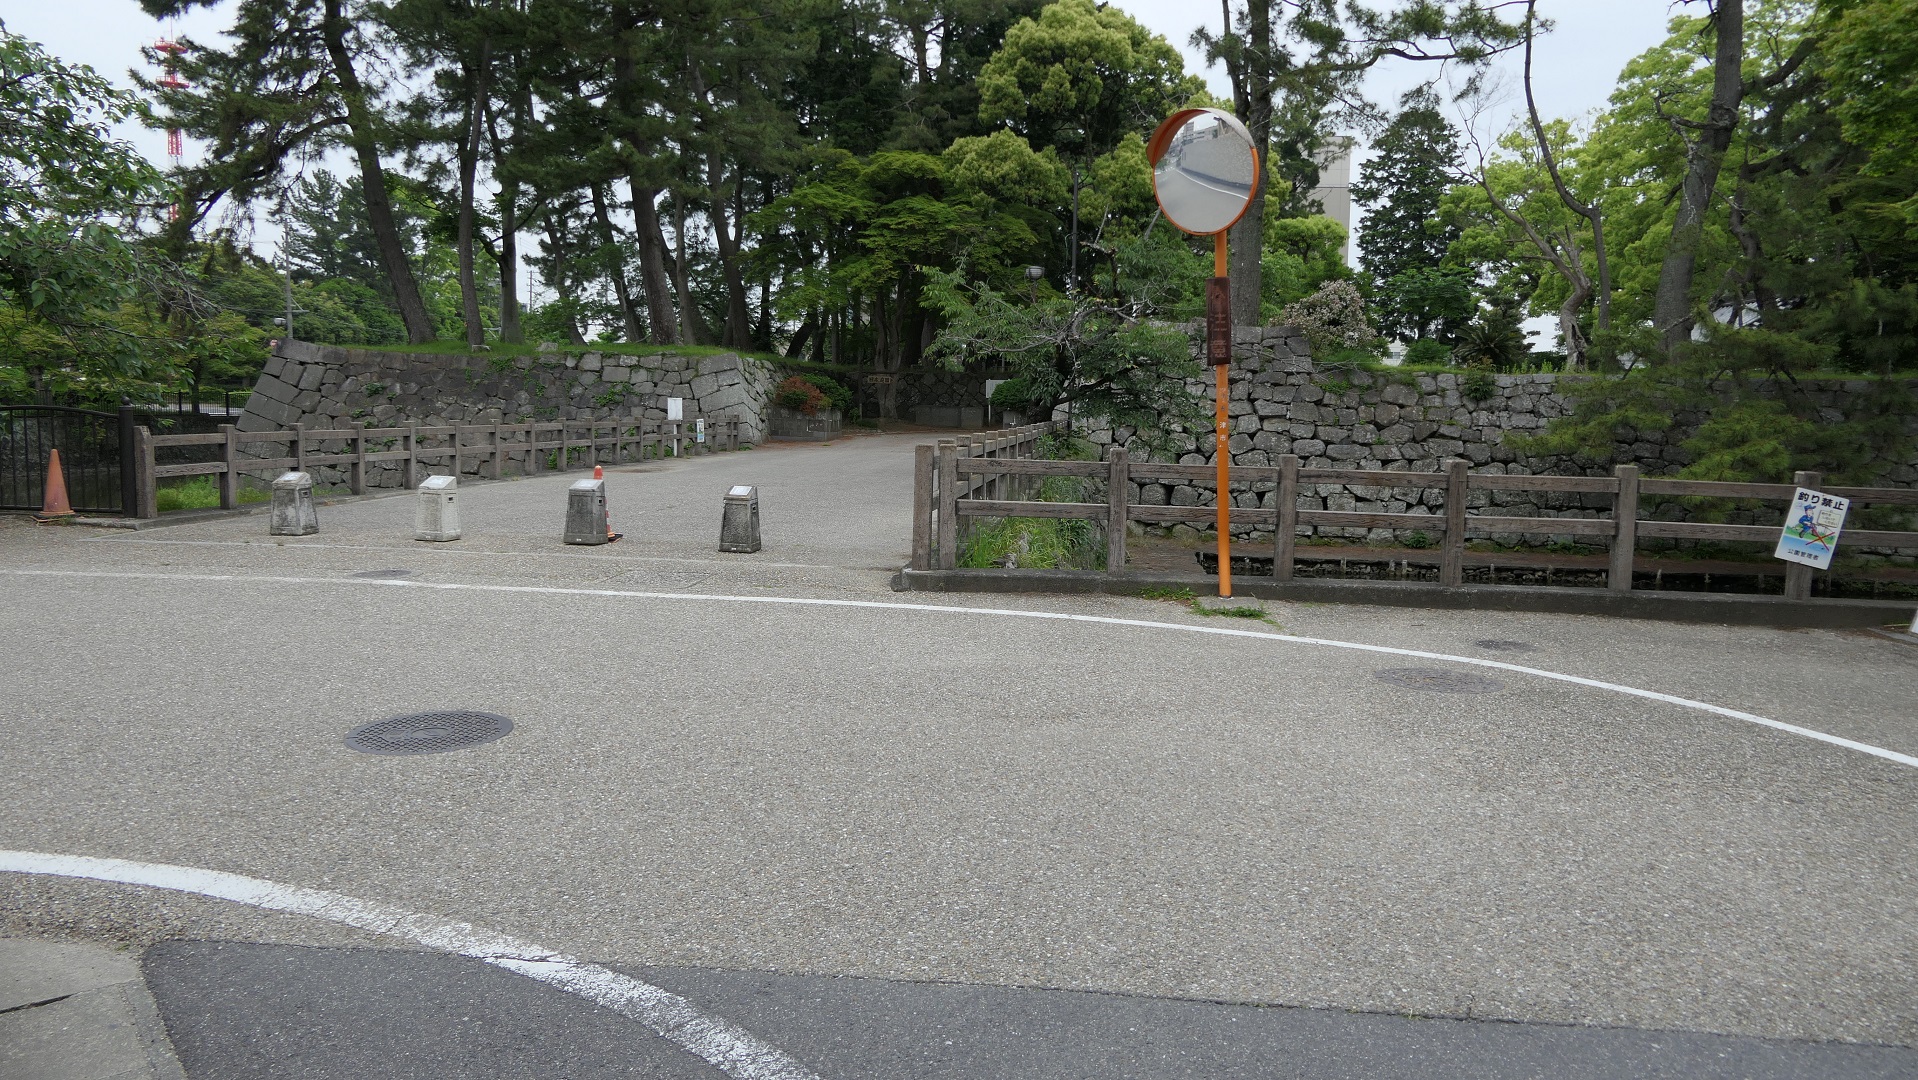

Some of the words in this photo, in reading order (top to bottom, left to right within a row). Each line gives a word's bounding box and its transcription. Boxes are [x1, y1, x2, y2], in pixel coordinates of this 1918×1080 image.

[1797, 491, 1845, 511] 釣り禁止
[1787, 548, 1819, 561] 公園管理者
